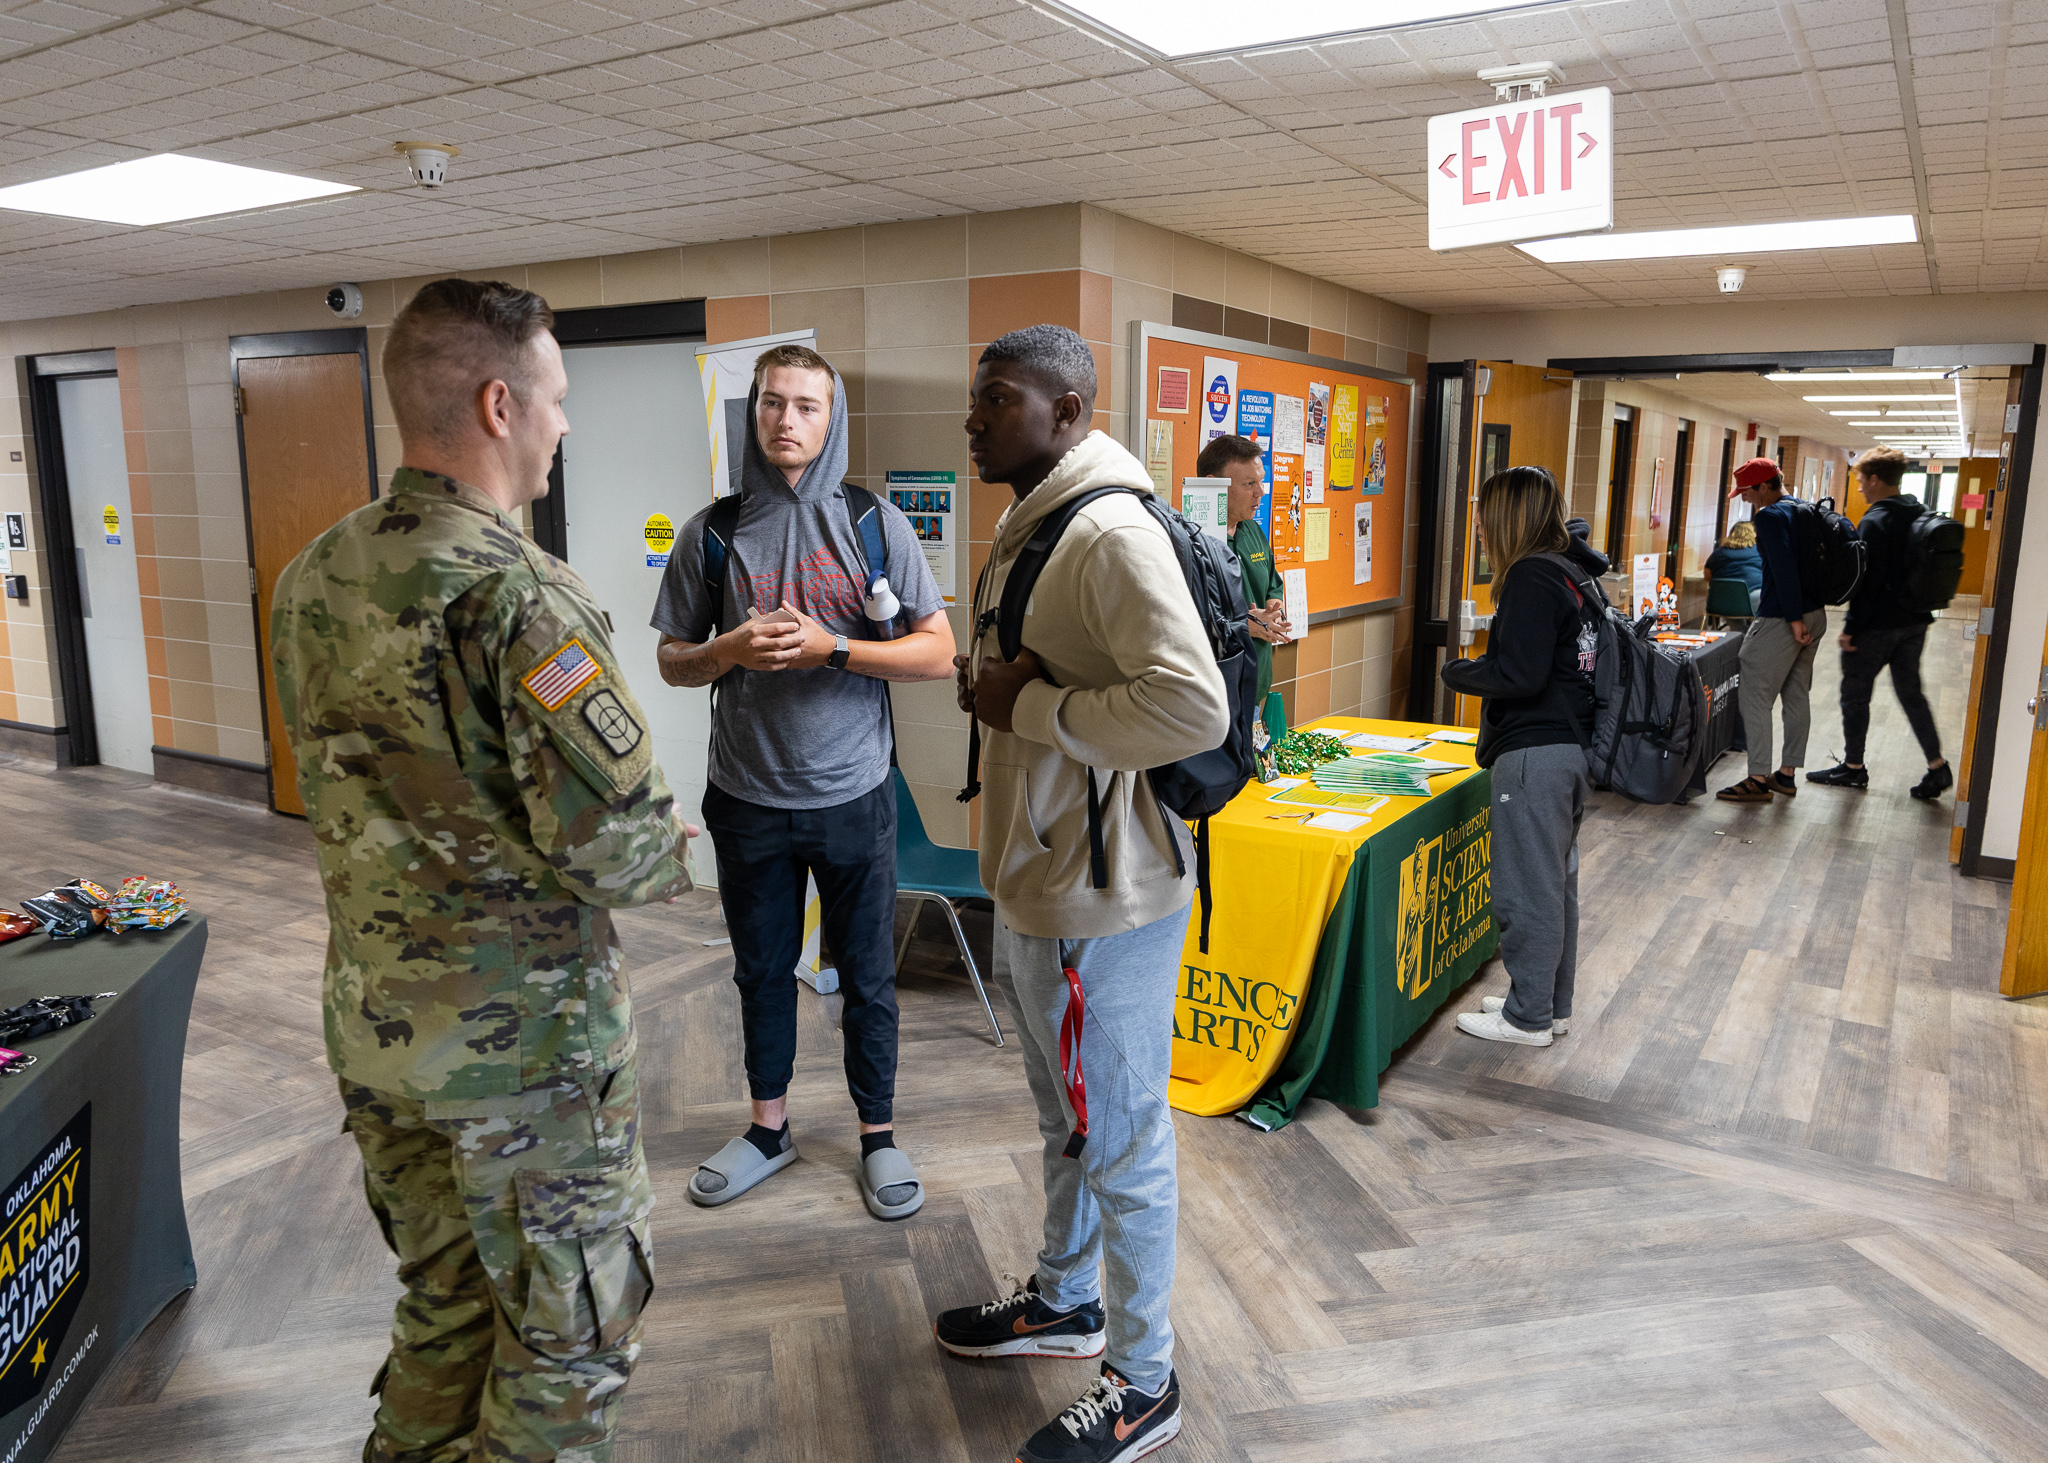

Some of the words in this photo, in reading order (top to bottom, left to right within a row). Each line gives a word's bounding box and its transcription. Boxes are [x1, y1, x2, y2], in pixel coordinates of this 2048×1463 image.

[1462, 102, 1583, 206] EXIT
[1336, 387, 1350, 405] Take
[1333, 404, 1343, 416] the
[1342, 405, 1357, 422] Next
[1337, 416, 1352, 438] Step
[1333, 442, 1356, 459] Central
[1340, 432, 1353, 449] Live
[1274, 455, 1294, 464] Degree
[1274, 464, 1289, 473] From
[1929, 465, 1940, 473] EXIT
[1273, 473, 1290, 482] Home
[645, 529, 673, 538] CAUTION
[1445, 806, 1491, 852] University
[1437, 905, 1452, 946] &
[1434, 952, 1445, 979] of
[1445, 915, 1491, 969] Oklahoma
[1175, 965, 1298, 1031] ENCE
[6, 1135, 72, 1218] OKLAHOMA
[0, 1159, 81, 1281] ARMY
[0, 1208, 80, 1319] NATIONAL
[0, 1235, 80, 1370] GUARD
[0, 1324, 99, 1463] NALGUARD.COM/OK
